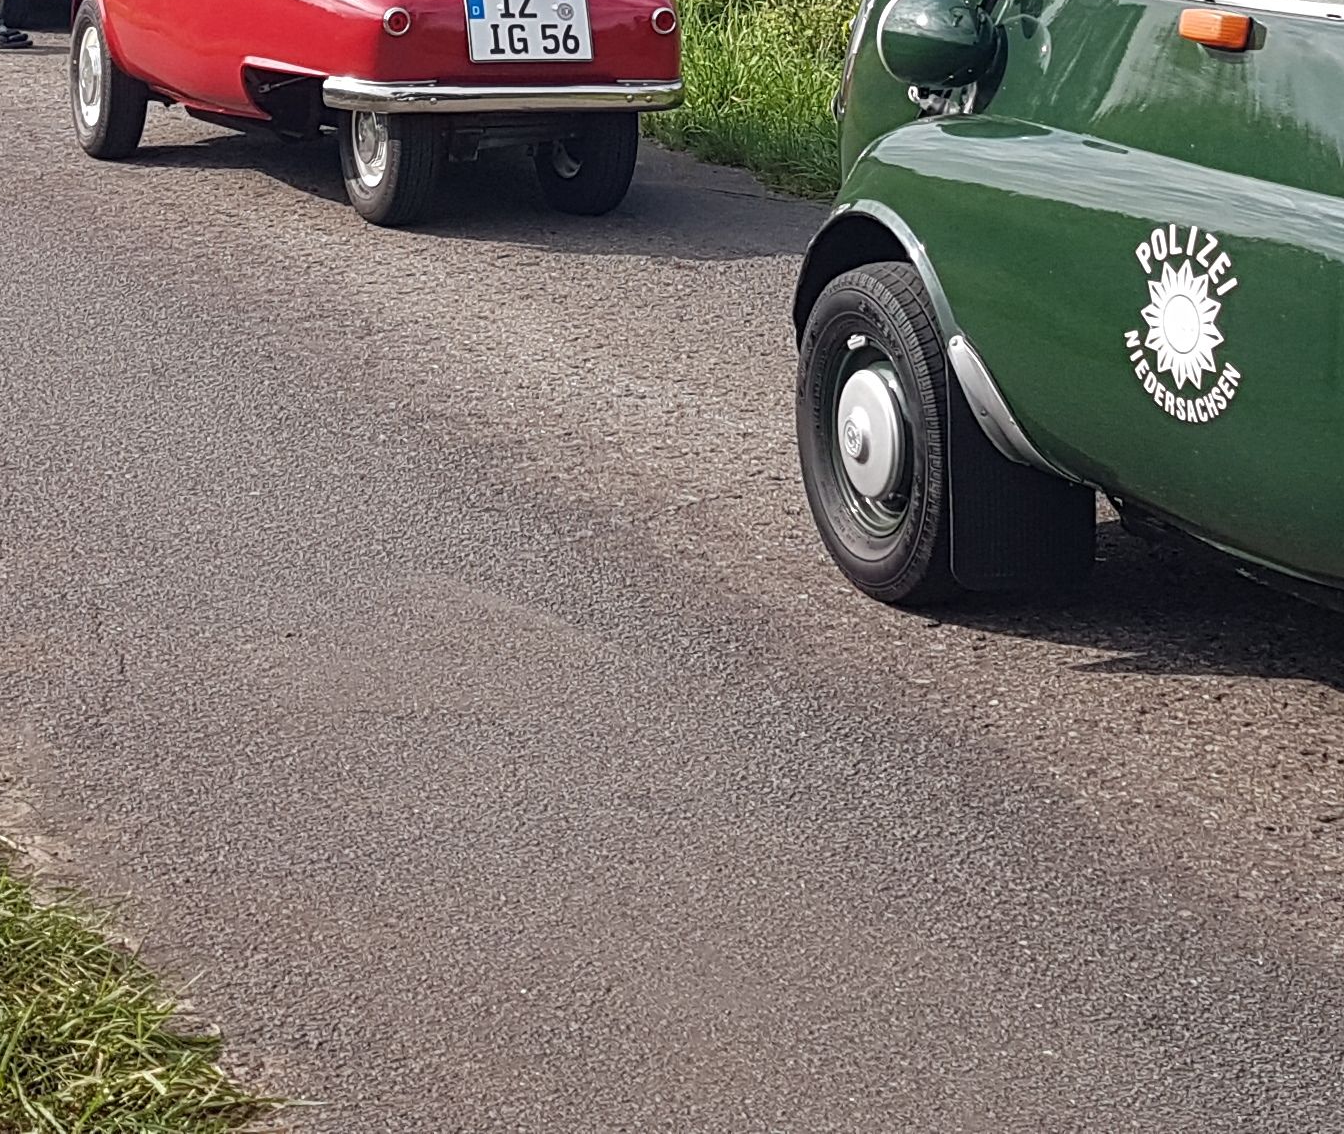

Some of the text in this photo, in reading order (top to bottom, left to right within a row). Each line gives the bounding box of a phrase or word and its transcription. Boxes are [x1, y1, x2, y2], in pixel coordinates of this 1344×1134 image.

[472, 6, 480, 15] D
[490, 24, 580, 55] IG 56
[1135, 223, 1238, 296] POLIZEI
[1123, 329, 1241, 423] NIEDERSACHSEN
